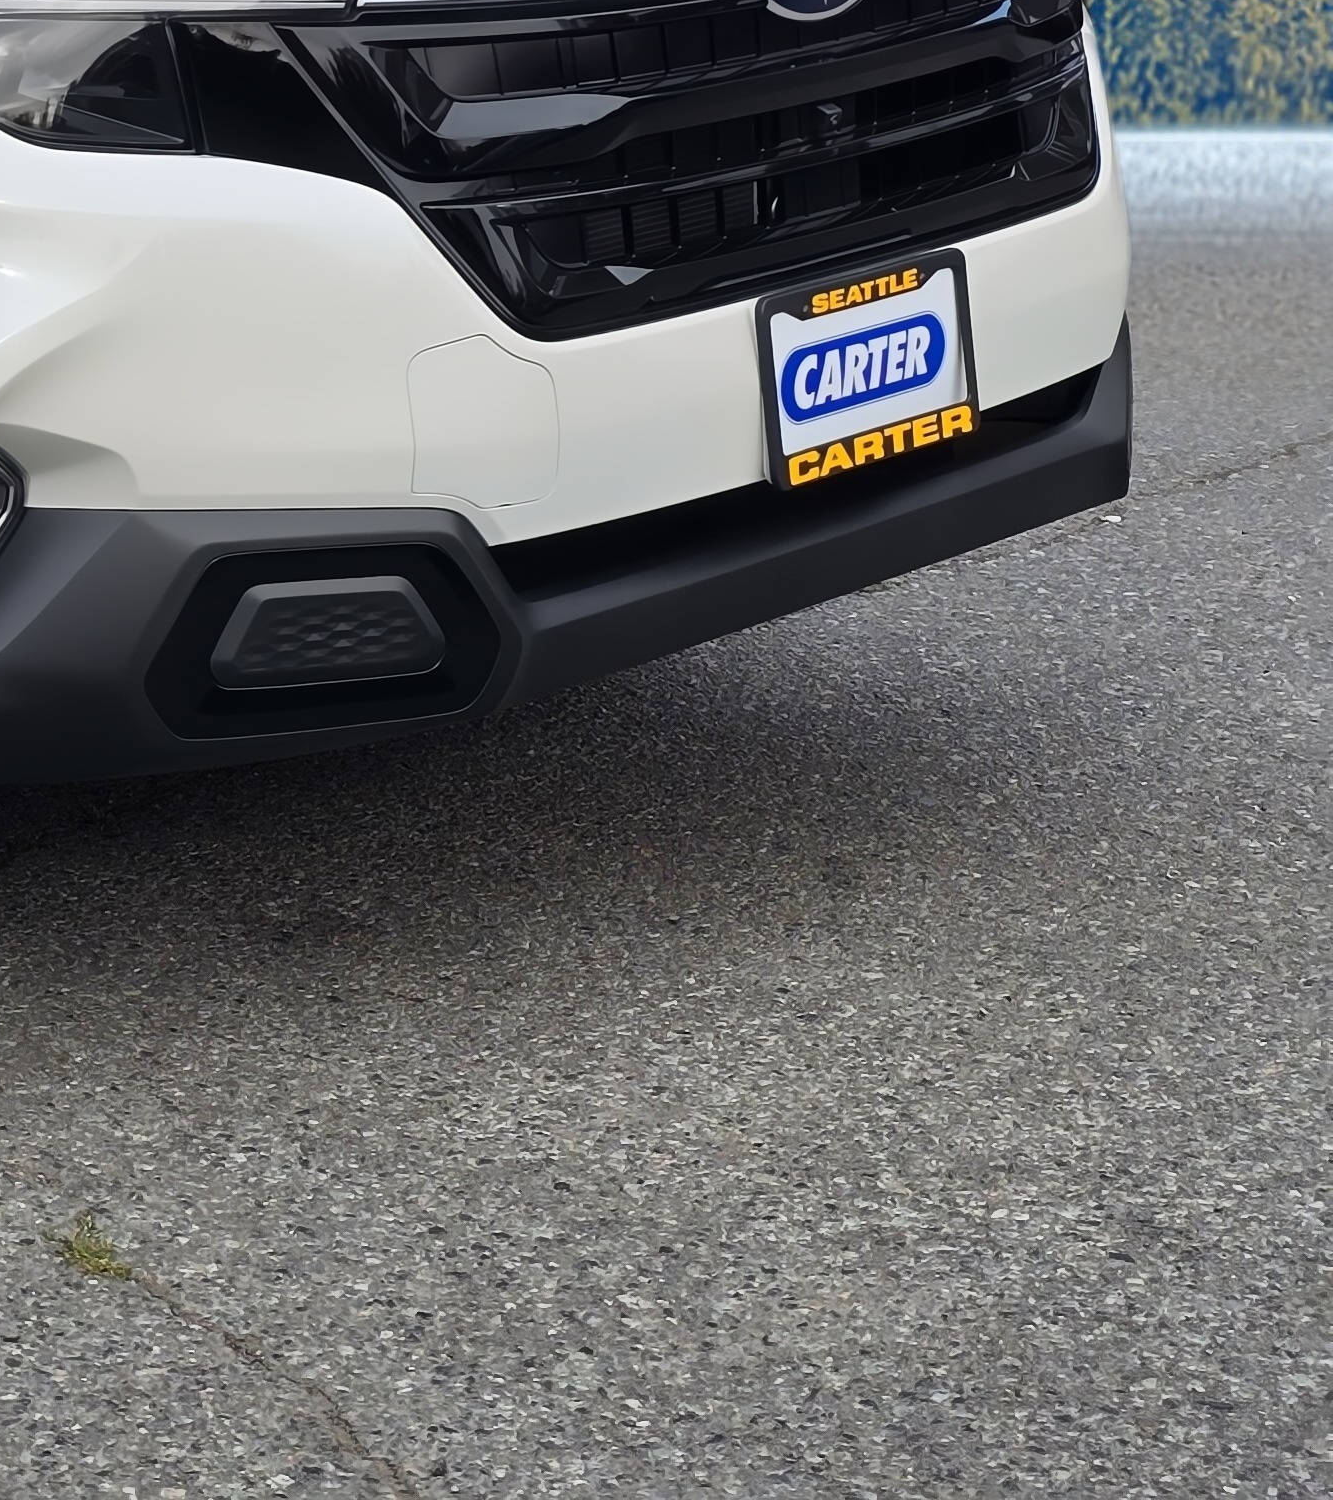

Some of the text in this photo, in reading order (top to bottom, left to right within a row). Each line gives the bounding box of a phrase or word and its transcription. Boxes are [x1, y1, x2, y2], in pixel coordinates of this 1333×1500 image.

[811, 267, 919, 314] SEATTLE
[793, 325, 931, 410] CARTER
[788, 405, 973, 486] CARTER
